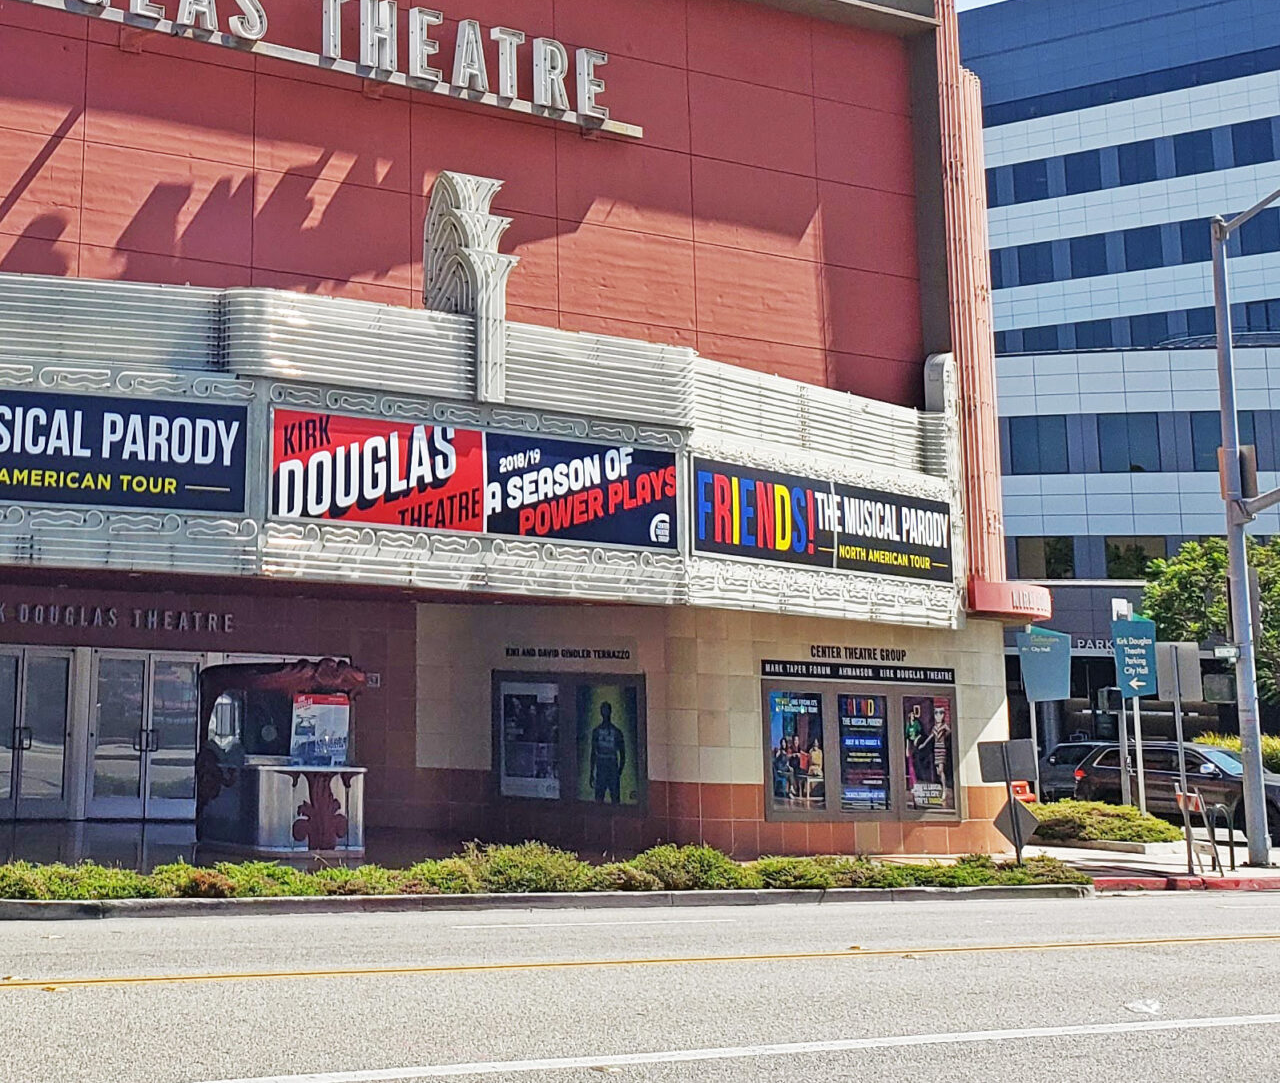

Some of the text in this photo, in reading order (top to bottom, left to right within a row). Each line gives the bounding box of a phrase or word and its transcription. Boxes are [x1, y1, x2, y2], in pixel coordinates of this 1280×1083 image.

[101, 412, 240, 467] PARODY
[283, 414, 330, 457] KIRK
[278, 425, 456, 519] DOUGLAS
[499, 448, 541, 474] 2018/19
[119, 474, 179, 495] TOUR
[486, 447, 635, 517] A SEASON OF
[397, 487, 481, 530] THEATRE
[519, 465, 677, 536] POWER PLAYS
[697, 470, 815, 555] FRIENDS!
[815, 491, 949, 549] THE MUSICAL PARODY
[839, 544, 931, 570] NORTH AMERICAN TOUR
[19, 603, 118, 629] DOUGLAS
[132, 607, 234, 634] THEATRE
[521, 648, 536, 657] AND
[538, 648, 559, 658] DAVID
[593, 649, 630, 660] TERRAZZO
[811, 645, 906, 662] CENTER THEATRE GROUP
[1116, 637, 1152, 646] Kirk Douglas
[1124, 647, 1146, 655] Theatre
[765, 663, 831, 675] MARK TAPER FORUM
[838, 667, 873, 676] AHMANSON
[1124, 667, 1135, 675] City
[1125, 657, 1146, 665] Parking
[880, 669, 952, 680] KIRK DOUGLAS THEATRE
